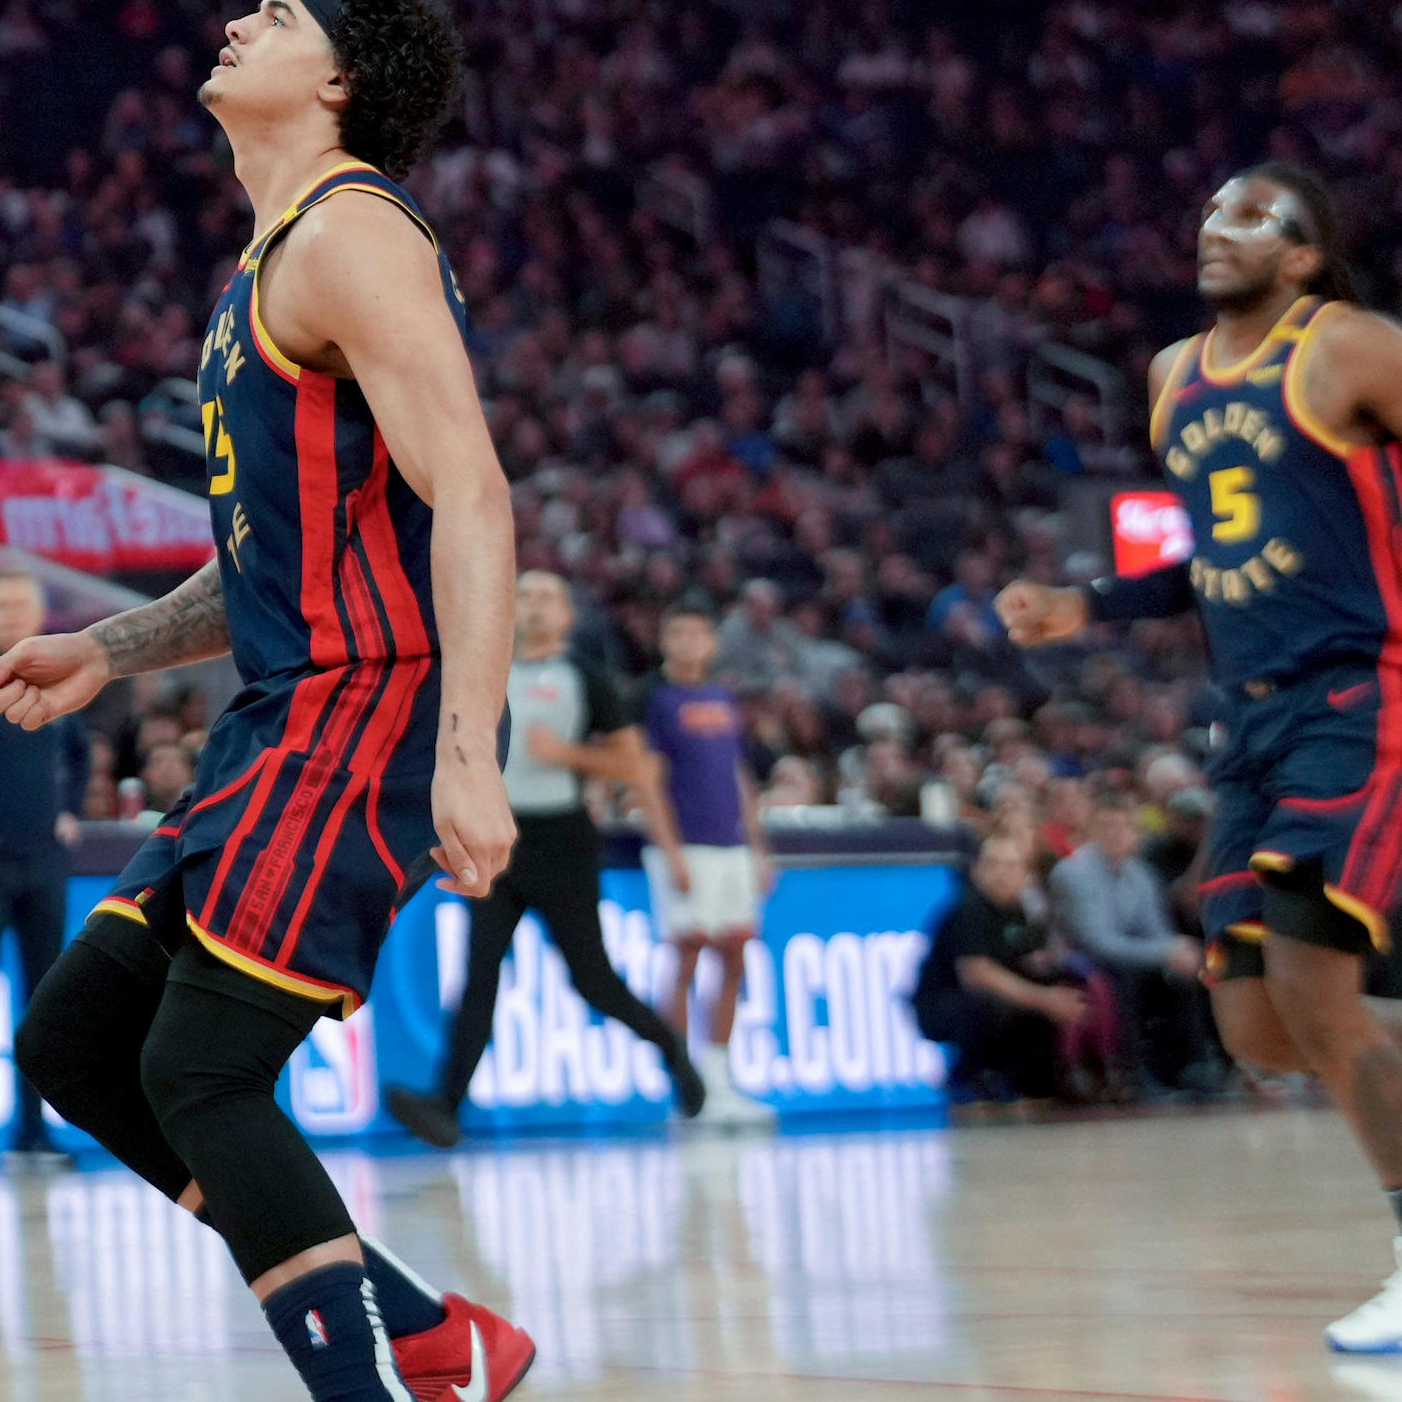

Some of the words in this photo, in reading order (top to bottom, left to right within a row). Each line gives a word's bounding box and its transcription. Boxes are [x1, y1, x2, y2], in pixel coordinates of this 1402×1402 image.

[1165, 401, 1285, 480] GOLDEN
[1208, 465, 1262, 544] 5
[1190, 537, 1302, 604] STATE
[251, 879, 272, 912] SAN
[273, 788, 314, 870] FRANCISCO
